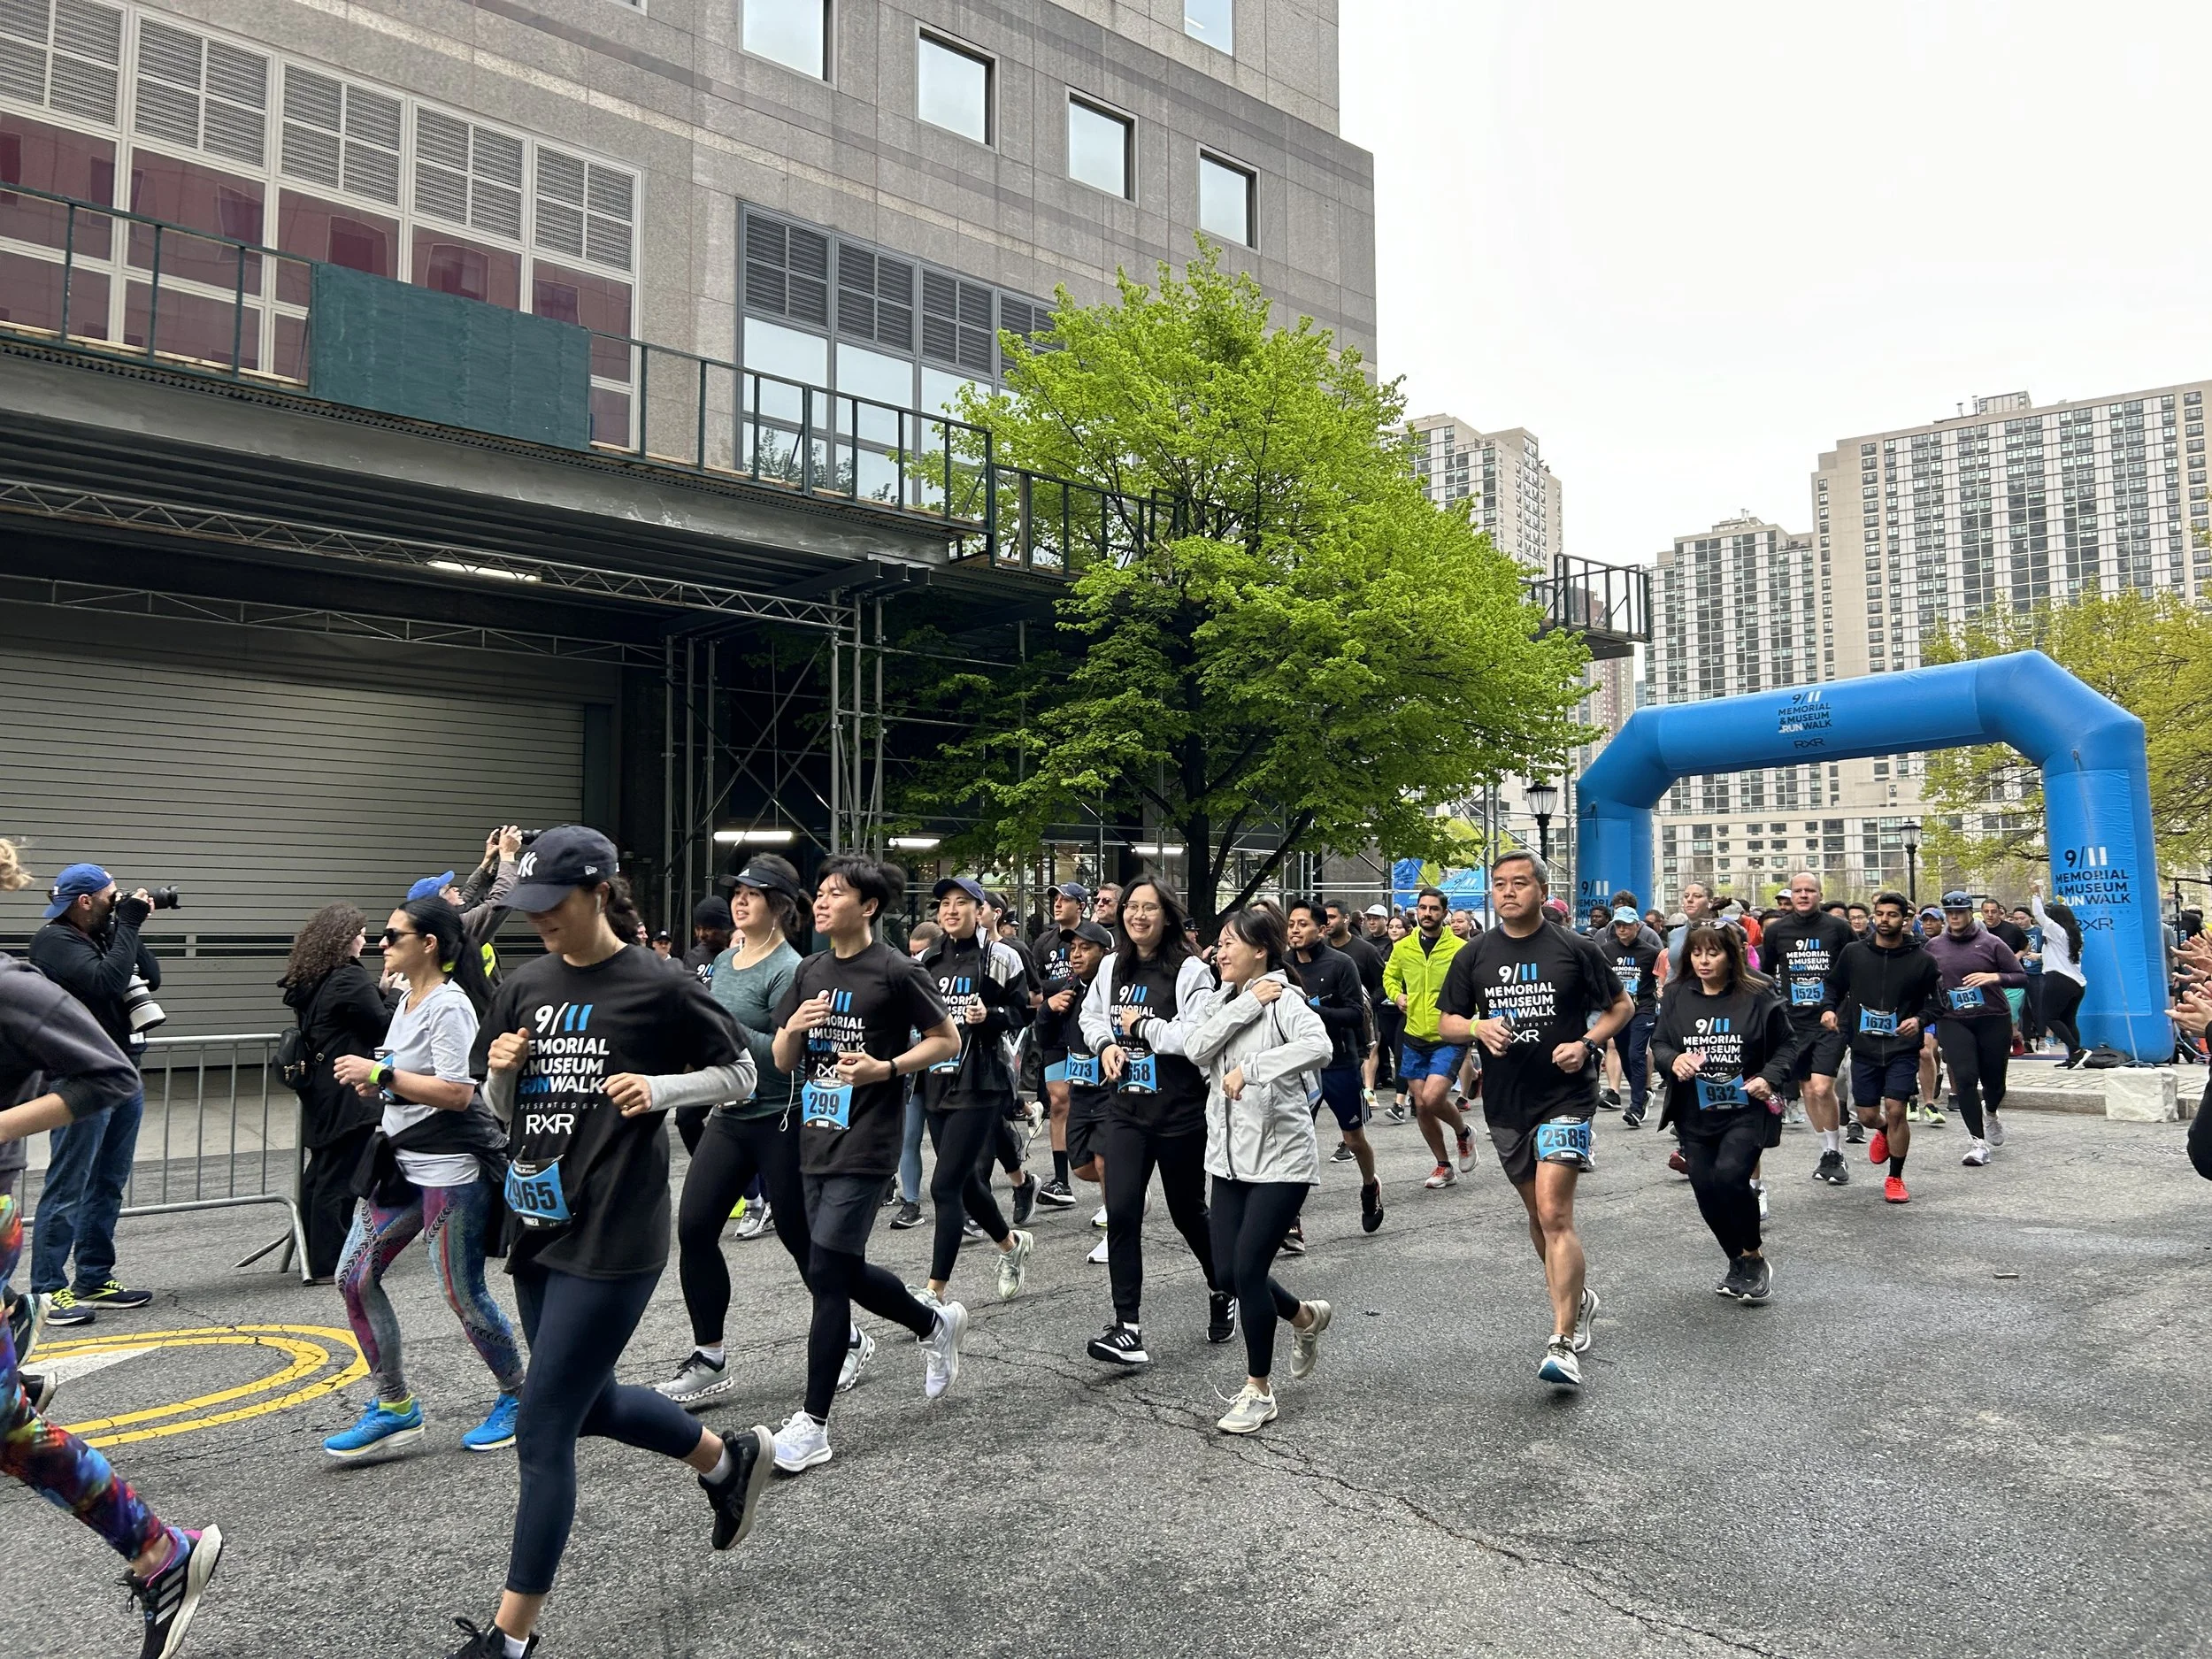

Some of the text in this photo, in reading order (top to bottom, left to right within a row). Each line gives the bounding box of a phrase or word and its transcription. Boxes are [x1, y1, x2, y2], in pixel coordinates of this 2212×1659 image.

[1792, 690, 1822, 705] 9/11
[1778, 702, 1832, 717] MEMORIAL
[1793, 737, 1825, 749] RXR
[2064, 846, 2108, 869] 9/11
[2055, 869, 2130, 885] MEMORIAL
[1581, 879, 1609, 897] 9/11
[1795, 938, 1820, 951] 9/11
[1617, 956, 1635, 966] 9/11
[1786, 950, 1831, 959] MEMORIAL
[1498, 962, 1537, 984] 9/11
[939, 975, 971, 995] 9/11
[1484, 981, 1556, 998] MEMORIAL
[826, 987, 853, 1013] /11
[1119, 983, 1148, 1004] 9/11
[1794, 987, 1821, 1000] 1525
[1956, 991, 1978, 1003] 483
[534, 1002, 593, 1036] 9/11
[1695, 1017, 1730, 1035] 9/11
[1865, 1016, 1893, 1030] 1673
[1512, 1029, 1540, 1042] XR
[1683, 1034, 1744, 1046] MEMORIAL
[528, 1037, 611, 1056] EMORIAL
[1069, 1062, 1093, 1078] 1273
[1706, 1086, 1739, 1102] 932
[809, 1091, 840, 1116] 299
[526, 1113, 575, 1135] RXR
[1542, 1128, 1587, 1150] 2585
